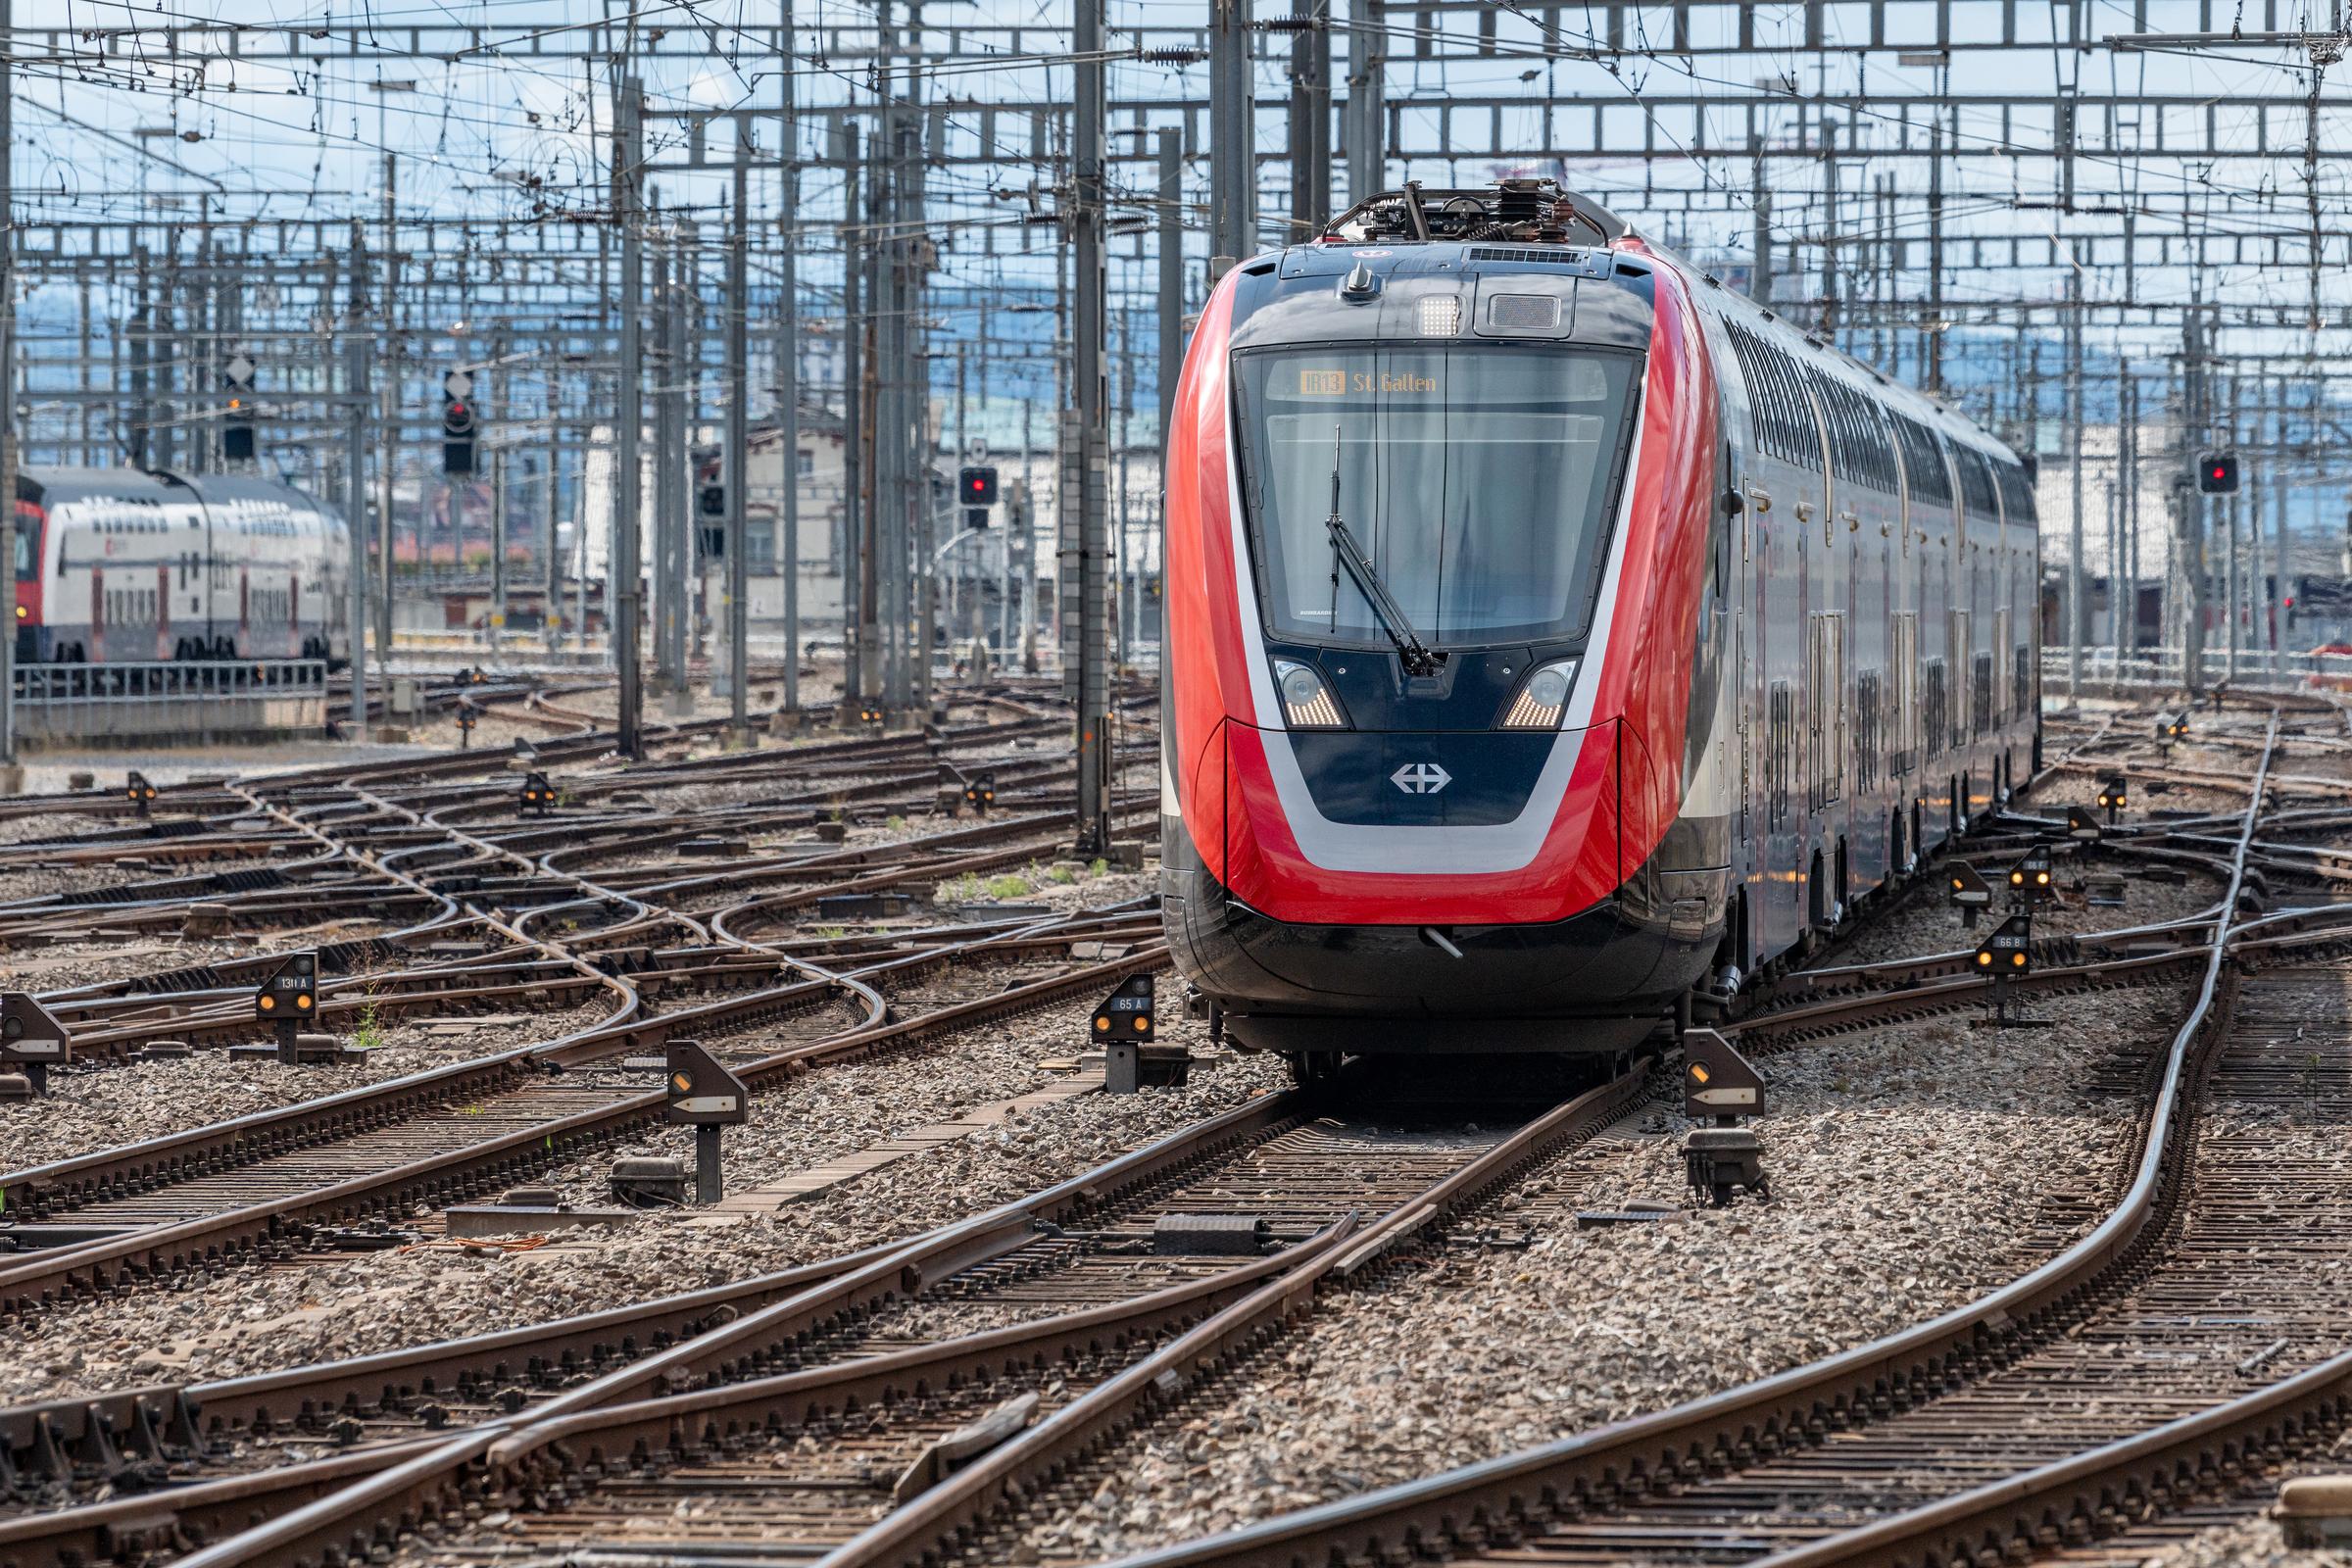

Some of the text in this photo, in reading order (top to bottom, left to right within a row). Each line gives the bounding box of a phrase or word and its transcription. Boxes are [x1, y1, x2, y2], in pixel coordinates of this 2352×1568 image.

[1353, 373, 1376, 392] St.
[1381, 373, 1436, 392] Gallen
[2000, 937, 2012, 947] 66
[300, 978, 307, 989] A
[1119, 999, 1143, 1009] 65 A
